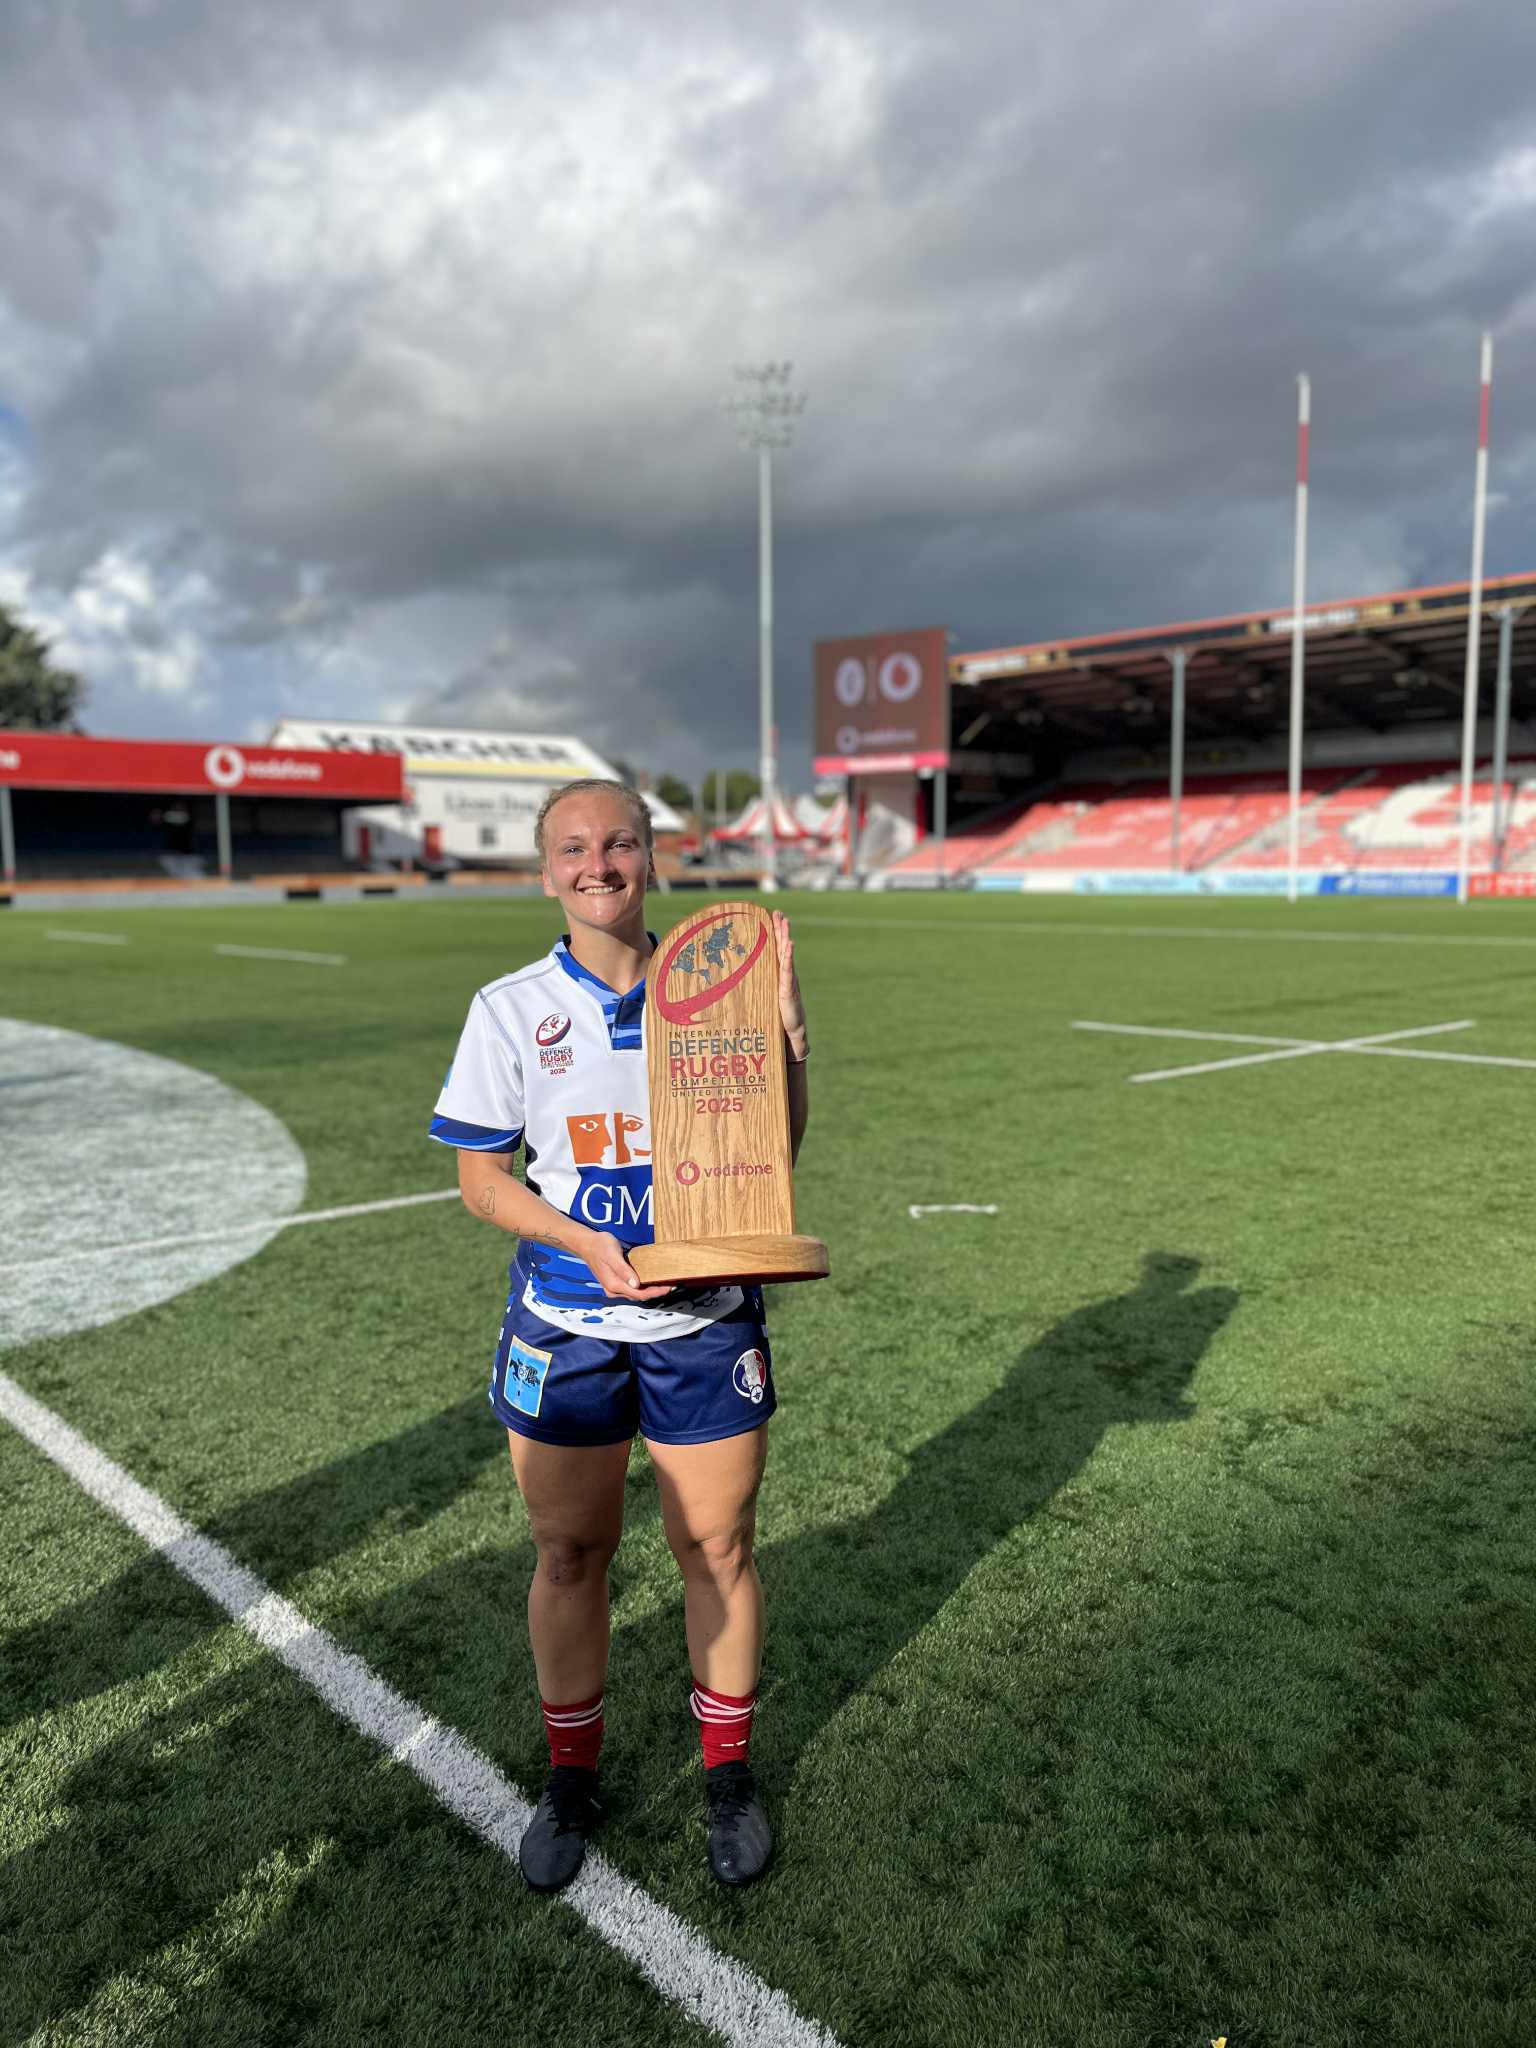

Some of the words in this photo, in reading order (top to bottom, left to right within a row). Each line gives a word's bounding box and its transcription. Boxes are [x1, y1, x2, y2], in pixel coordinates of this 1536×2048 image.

[669, 1027, 765, 1039] INTERNATIONAL
[540, 1048, 573, 1056] DEFENCE
[669, 1036, 766, 1056] DEFENCE
[540, 1054, 573, 1065] RUGBY
[669, 1054, 766, 1078] RUGBY
[671, 1075, 766, 1087] COMPETITION
[672, 1089, 711, 1098] UNITED
[717, 1087, 767, 1096] KINGDOM
[696, 1097, 743, 1114] 2025
[704, 1163, 773, 1178] vodafone
